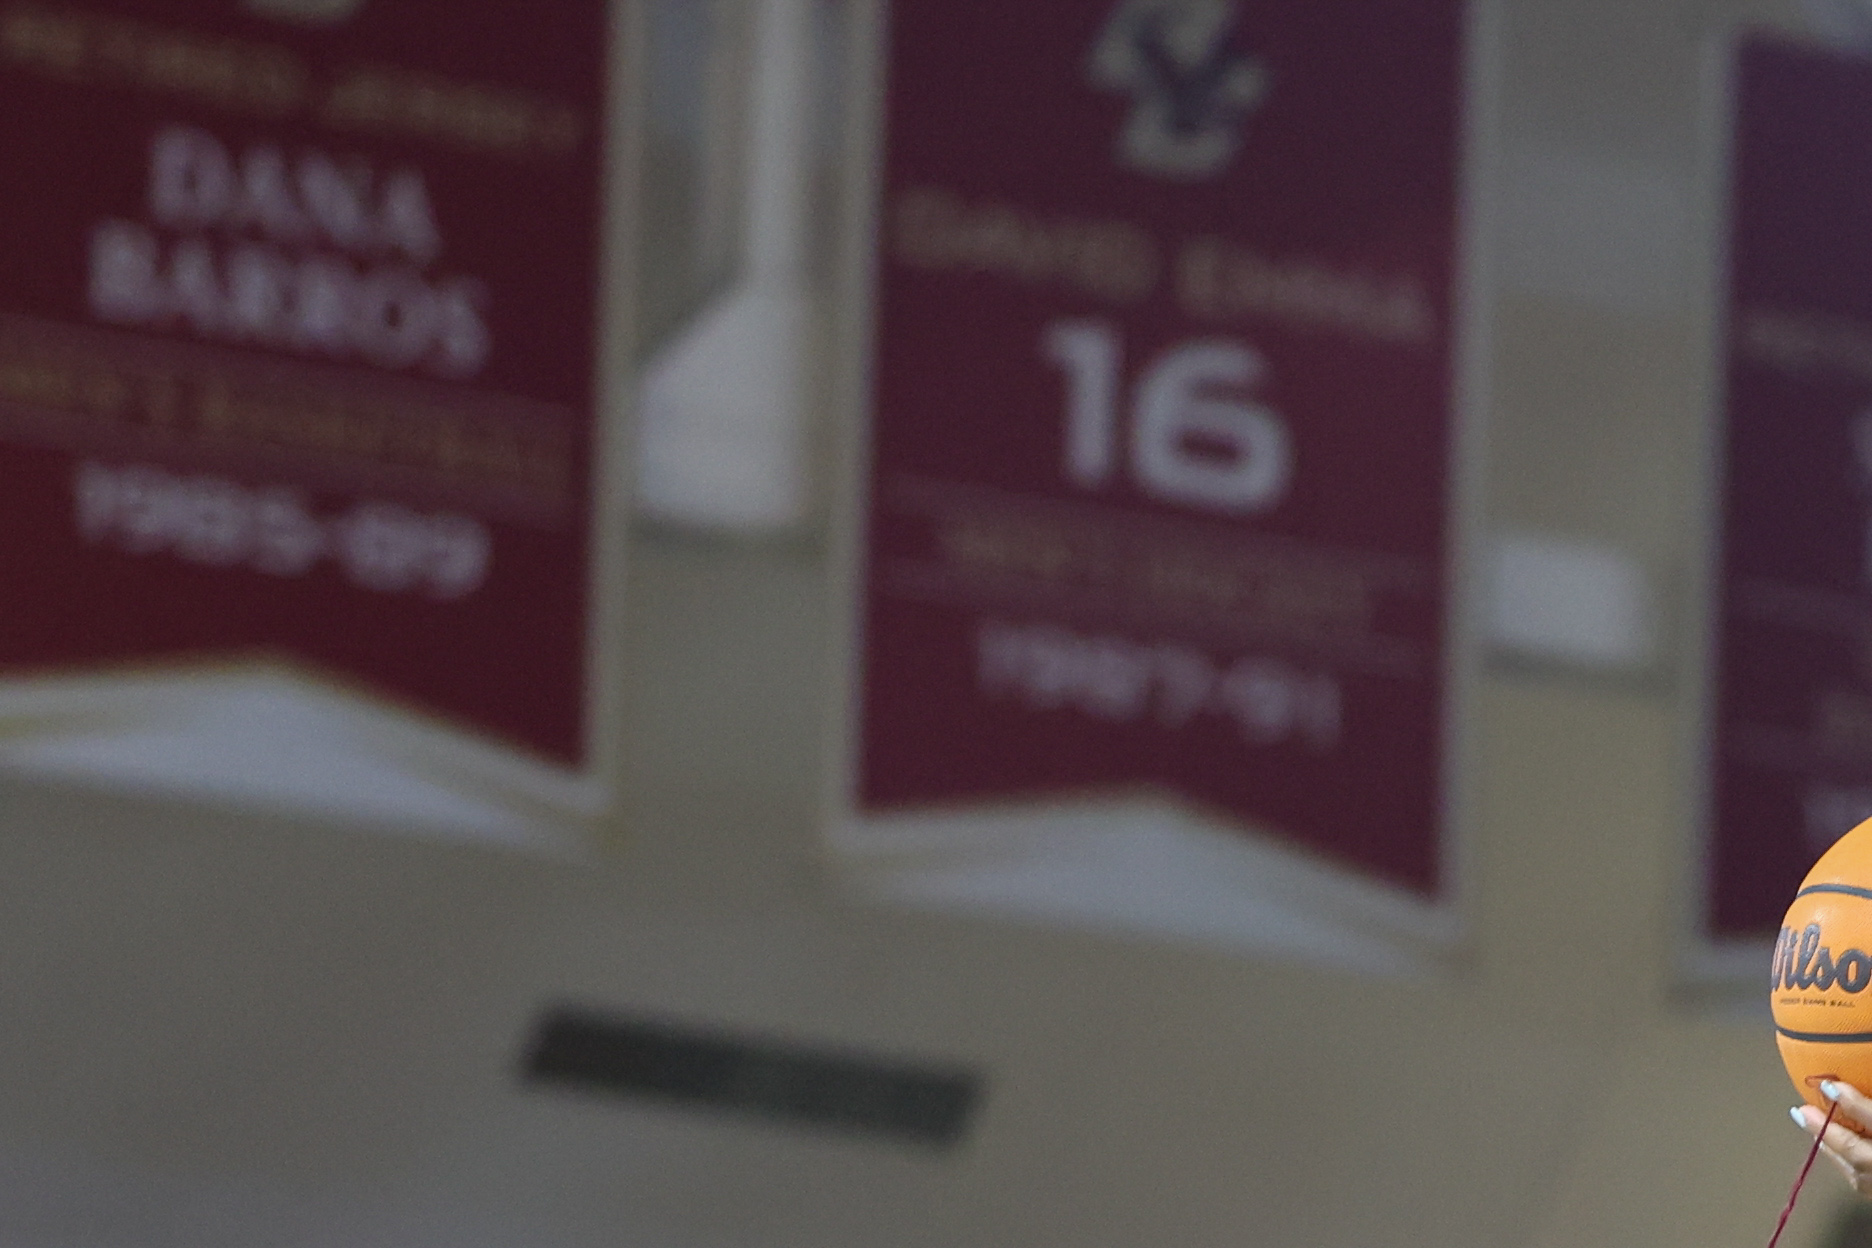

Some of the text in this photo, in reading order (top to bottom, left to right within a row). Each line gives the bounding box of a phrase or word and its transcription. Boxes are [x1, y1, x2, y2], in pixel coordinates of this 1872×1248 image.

[150, 125, 442, 263] DANA
[88, 219, 492, 378] BARROS
[1042, 317, 1296, 518] 16
